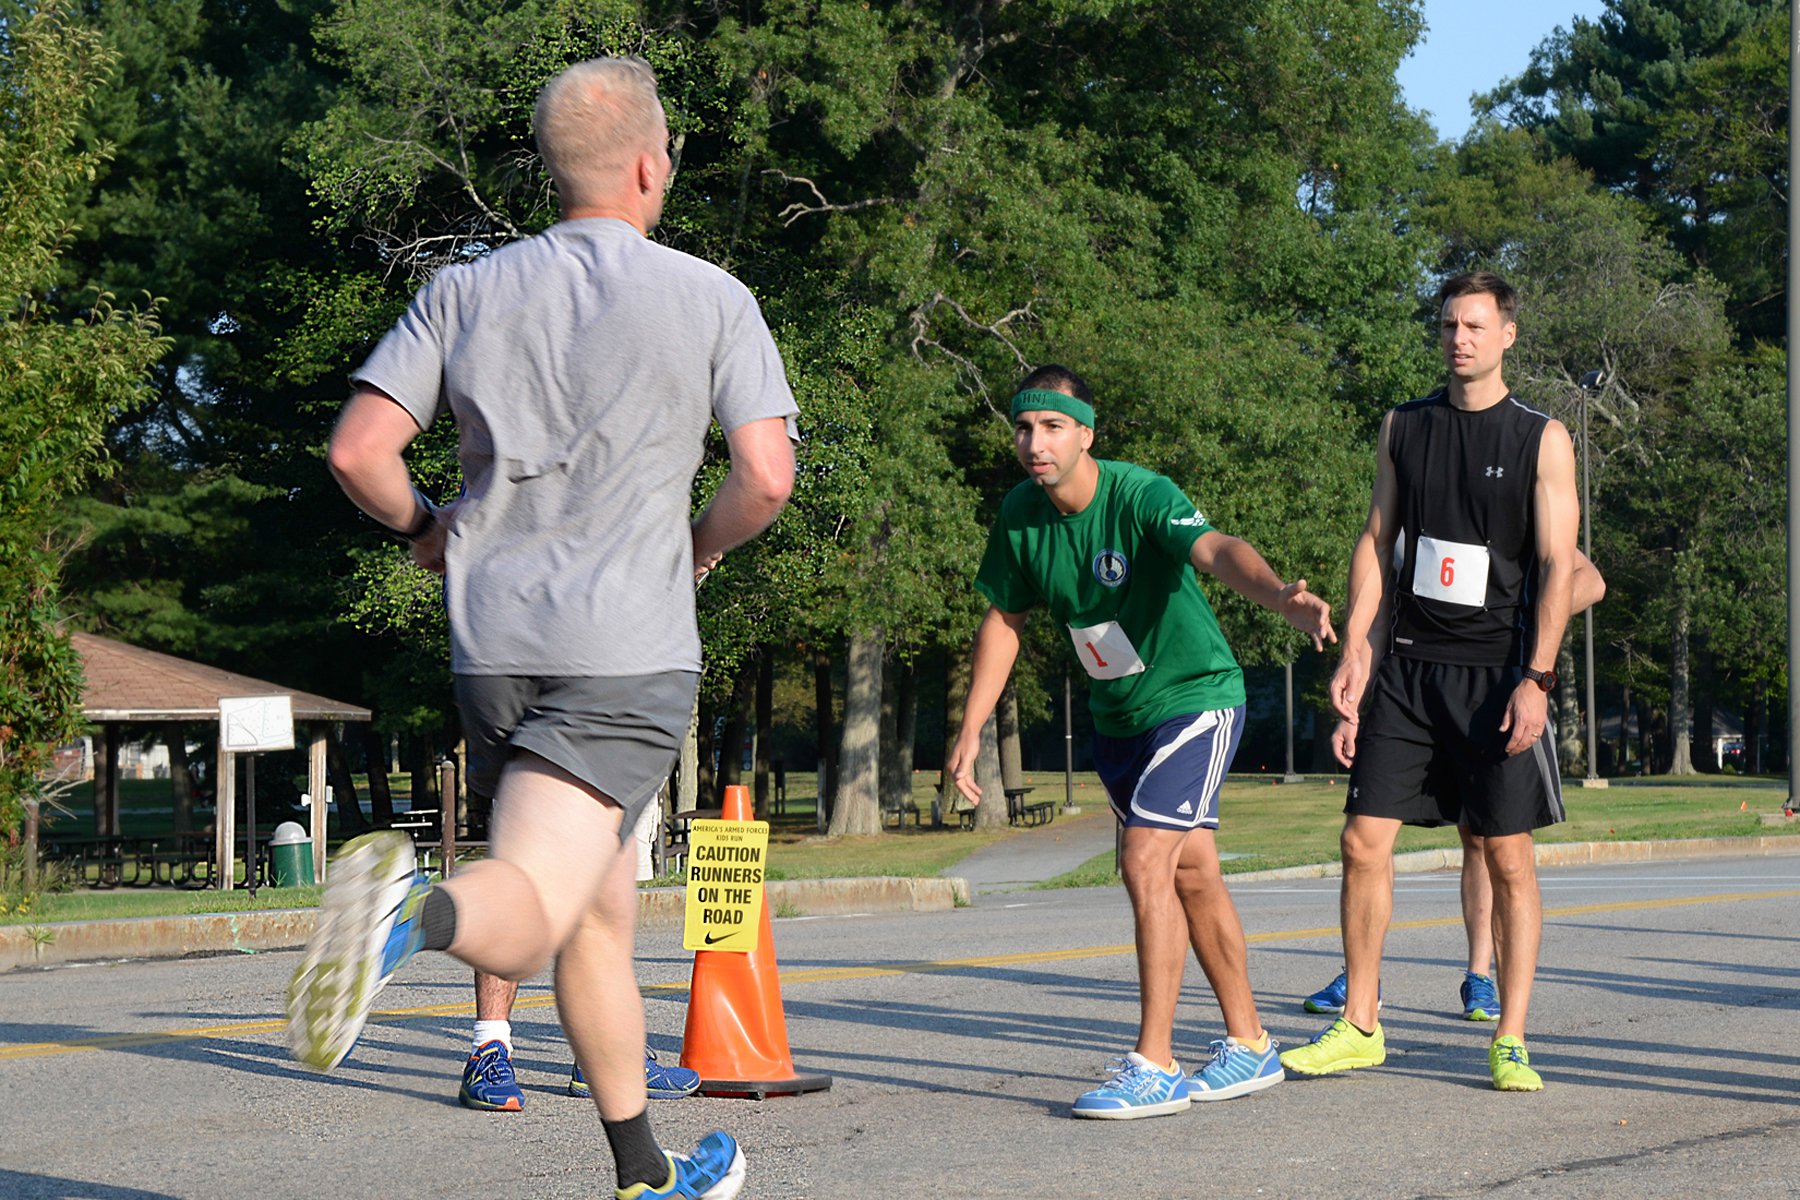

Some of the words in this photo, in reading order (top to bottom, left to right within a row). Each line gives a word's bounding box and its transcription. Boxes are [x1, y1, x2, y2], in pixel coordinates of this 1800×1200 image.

[1440, 556, 1455, 587] 6
[1085, 641, 1108, 668] 1
[692, 825, 723, 833] AMERICA'S
[696, 845, 760, 863] CAUTION
[690, 866, 762, 884] RUNNERS
[697, 887, 719, 903] ON
[724, 888, 752, 904] THE
[703, 908, 743, 925] ROAD
